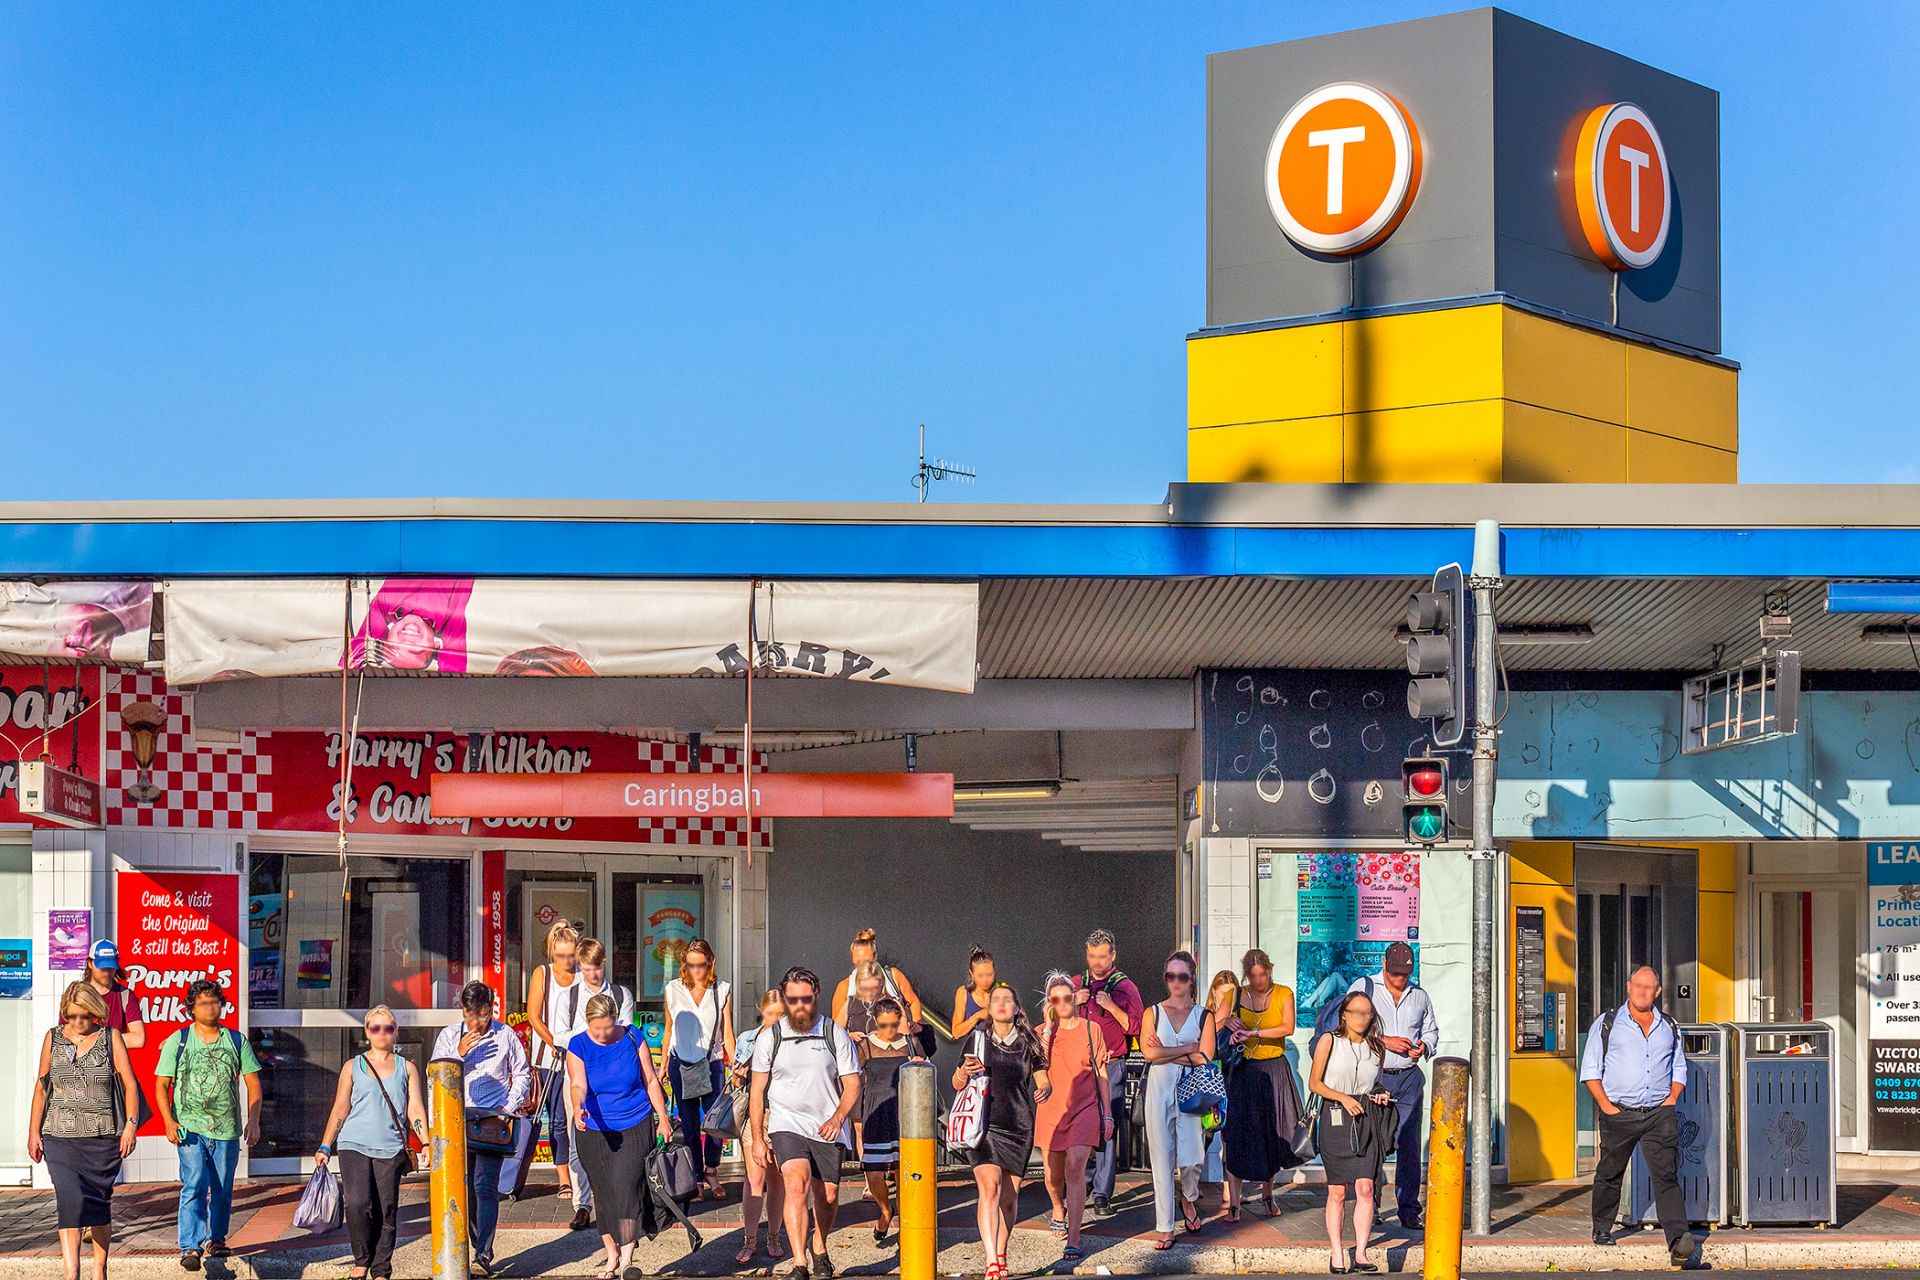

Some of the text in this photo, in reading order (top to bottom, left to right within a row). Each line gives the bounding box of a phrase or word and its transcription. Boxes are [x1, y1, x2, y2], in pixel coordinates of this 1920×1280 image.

[1308, 126, 1366, 215] T
[1619, 144, 1650, 233] T
[324, 731, 591, 779] Parry's Milkbar
[326, 782, 470, 835] & Can
[1877, 845, 1920, 864] LEA
[141, 890, 213, 908] Come & visit
[1877, 899, 1920, 911] Prime
[142, 914, 210, 935] the Original
[492, 890, 502, 975] since 1958
[132, 938, 143, 955] &
[145, 938, 169, 955] still
[171, 938, 191, 956] the
[193, 938, 219, 956] Best
[1886, 945, 1899, 953] 76
[1352, 954, 1386, 962] NAKE
[124, 964, 233, 991] Parry's
[1886, 973, 1899, 981] All
[1680, 985, 1688, 996] C
[139, 996, 235, 1023] ilkr
[1886, 1001, 1920, 1009] Over 3
[1876, 1047, 1920, 1059] VICTO
[1875, 1078, 1901, 1087] 0409
[1876, 1090, 1917, 1100] 02 8238
